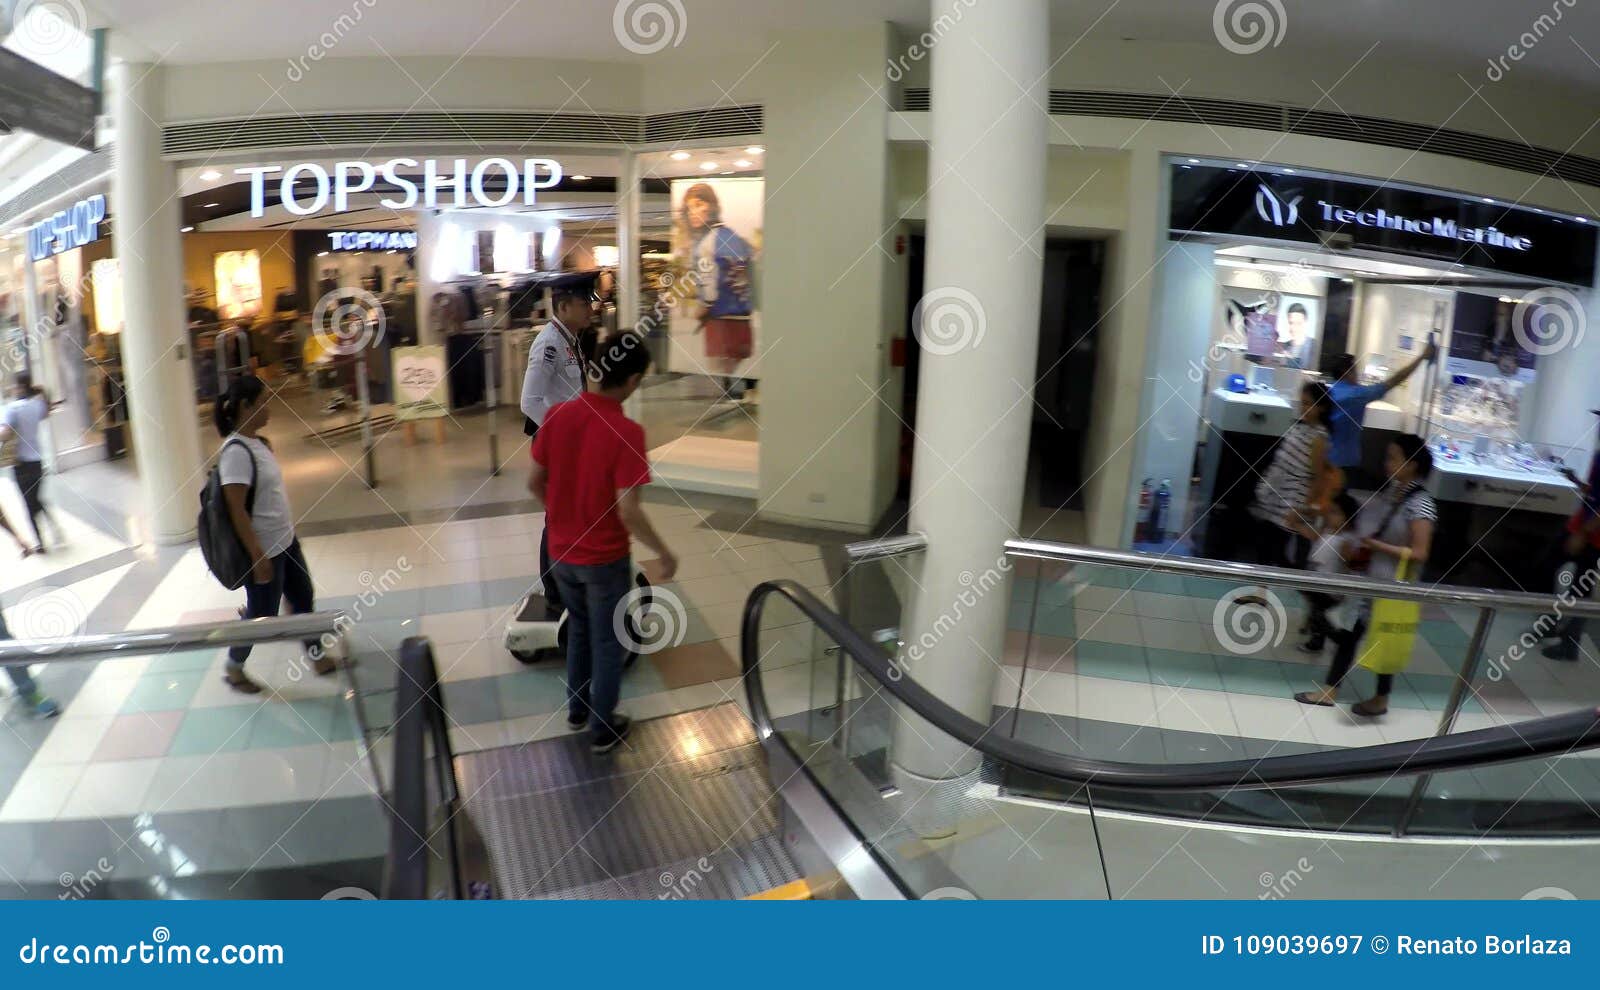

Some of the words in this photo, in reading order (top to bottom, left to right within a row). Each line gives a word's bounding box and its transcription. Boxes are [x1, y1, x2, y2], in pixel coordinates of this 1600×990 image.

[234, 157, 563, 218] TOPSHOP
[29, 194, 105, 261] OPSHOP
[327, 231, 417, 250] TOPMAN
[1318, 200, 1533, 251] TechnoMarine
